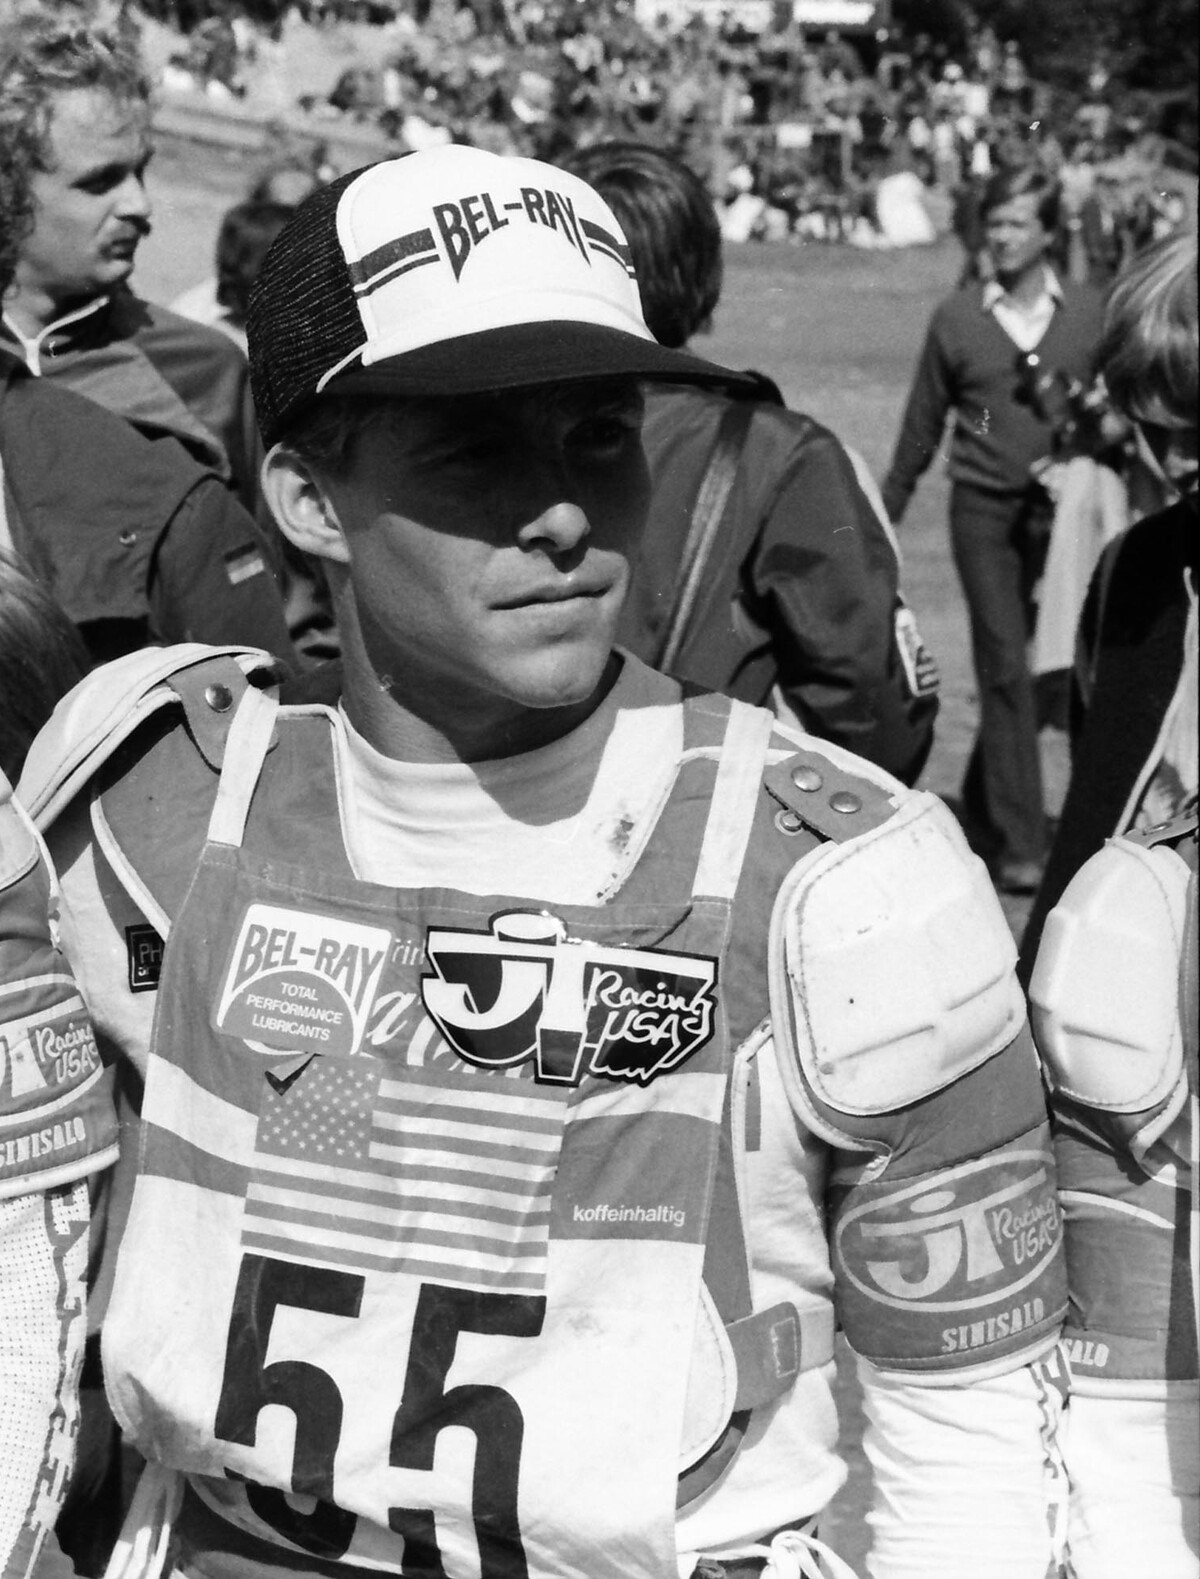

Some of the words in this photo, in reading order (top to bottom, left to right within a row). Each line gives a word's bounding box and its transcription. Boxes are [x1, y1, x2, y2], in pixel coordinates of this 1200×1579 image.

[433, 188, 591, 283] BEL-RAY
[232, 924, 384, 1015] BEL-RAY
[246, 994, 343, 1025] PERFORMANCE
[281, 982, 318, 1001] TOTAL
[588, 967, 712, 1034] Racing
[252, 1014, 330, 1041] LUBRICANTS
[604, 1009, 681, 1046] USA
[55, 1044, 96, 1084] USA
[573, 1205, 685, 1227] koffeinhaltig
[1013, 1221, 1052, 1265] USA
[941, 1298, 1044, 1352] SINISALO
[214, 1252, 547, 1579] 55
